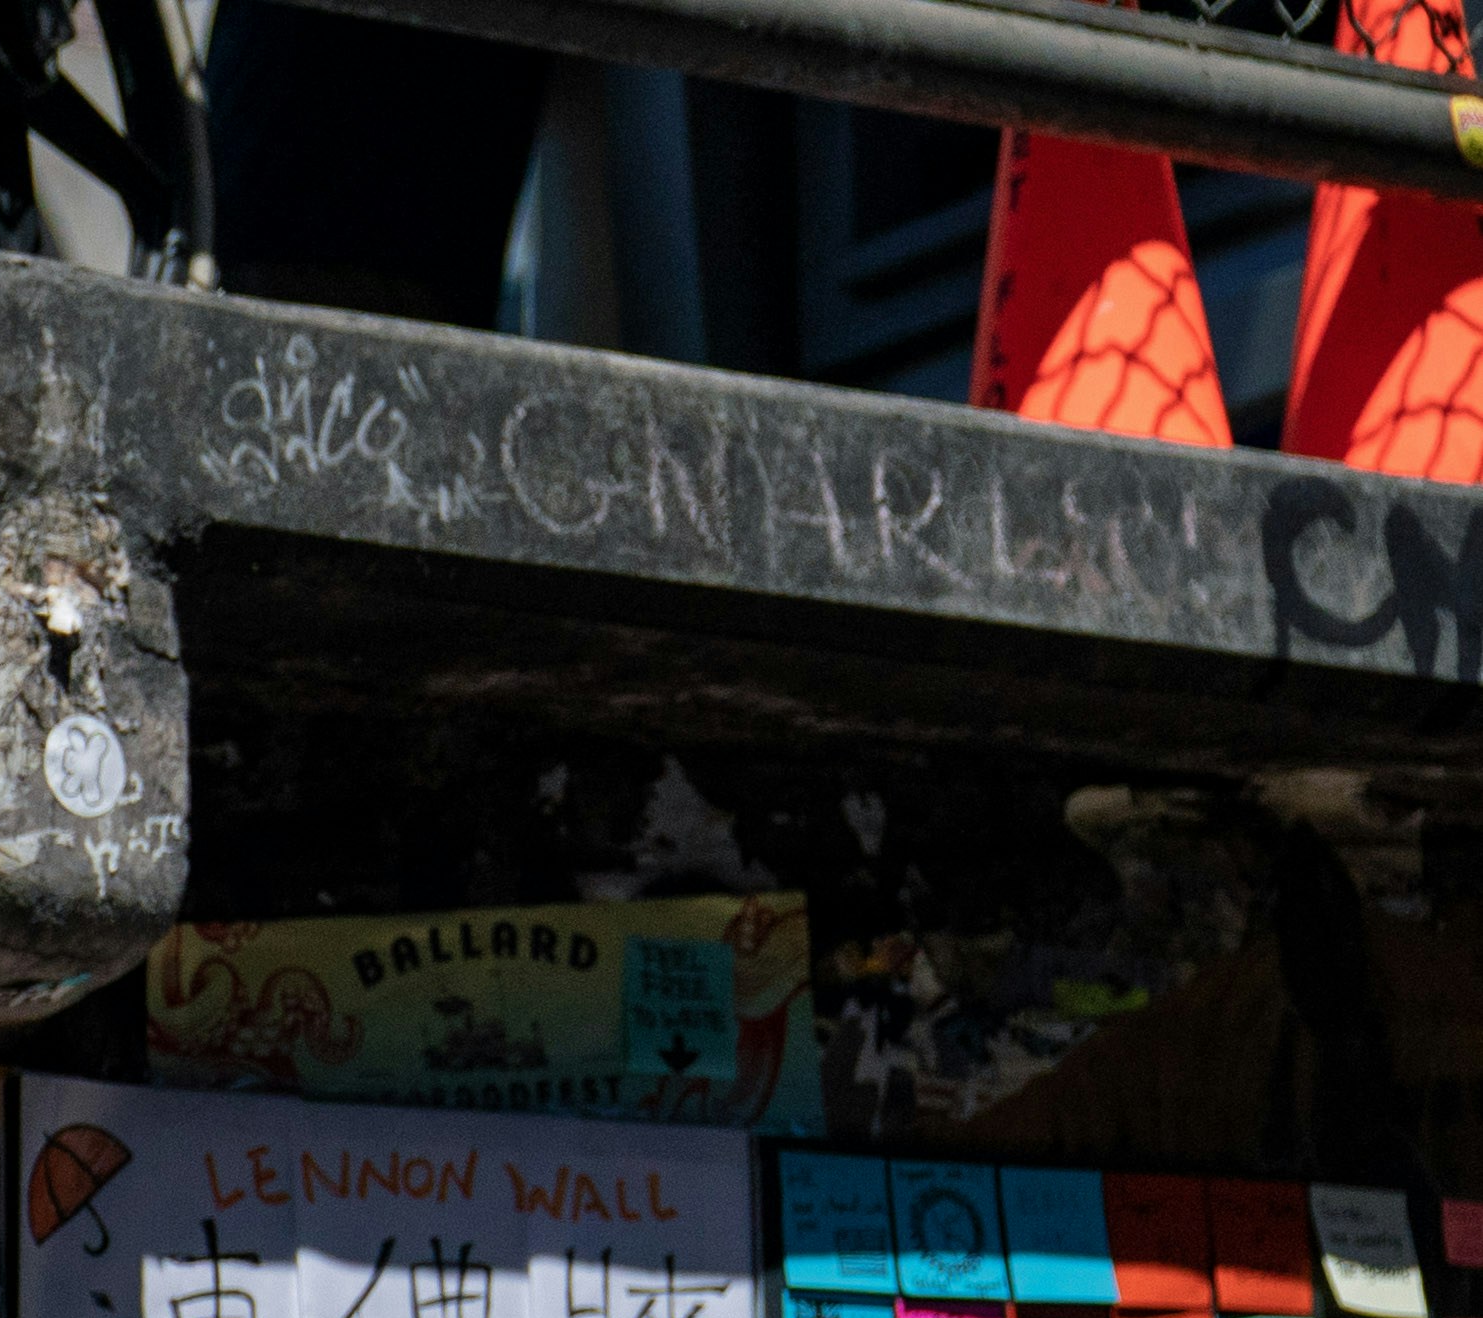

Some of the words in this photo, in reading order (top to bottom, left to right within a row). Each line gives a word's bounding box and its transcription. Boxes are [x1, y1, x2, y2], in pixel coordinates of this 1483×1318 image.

[356, 920, 599, 989] BALLARD
[205, 1146, 478, 1209] LENNON
[506, 1166, 678, 1223] WALL
